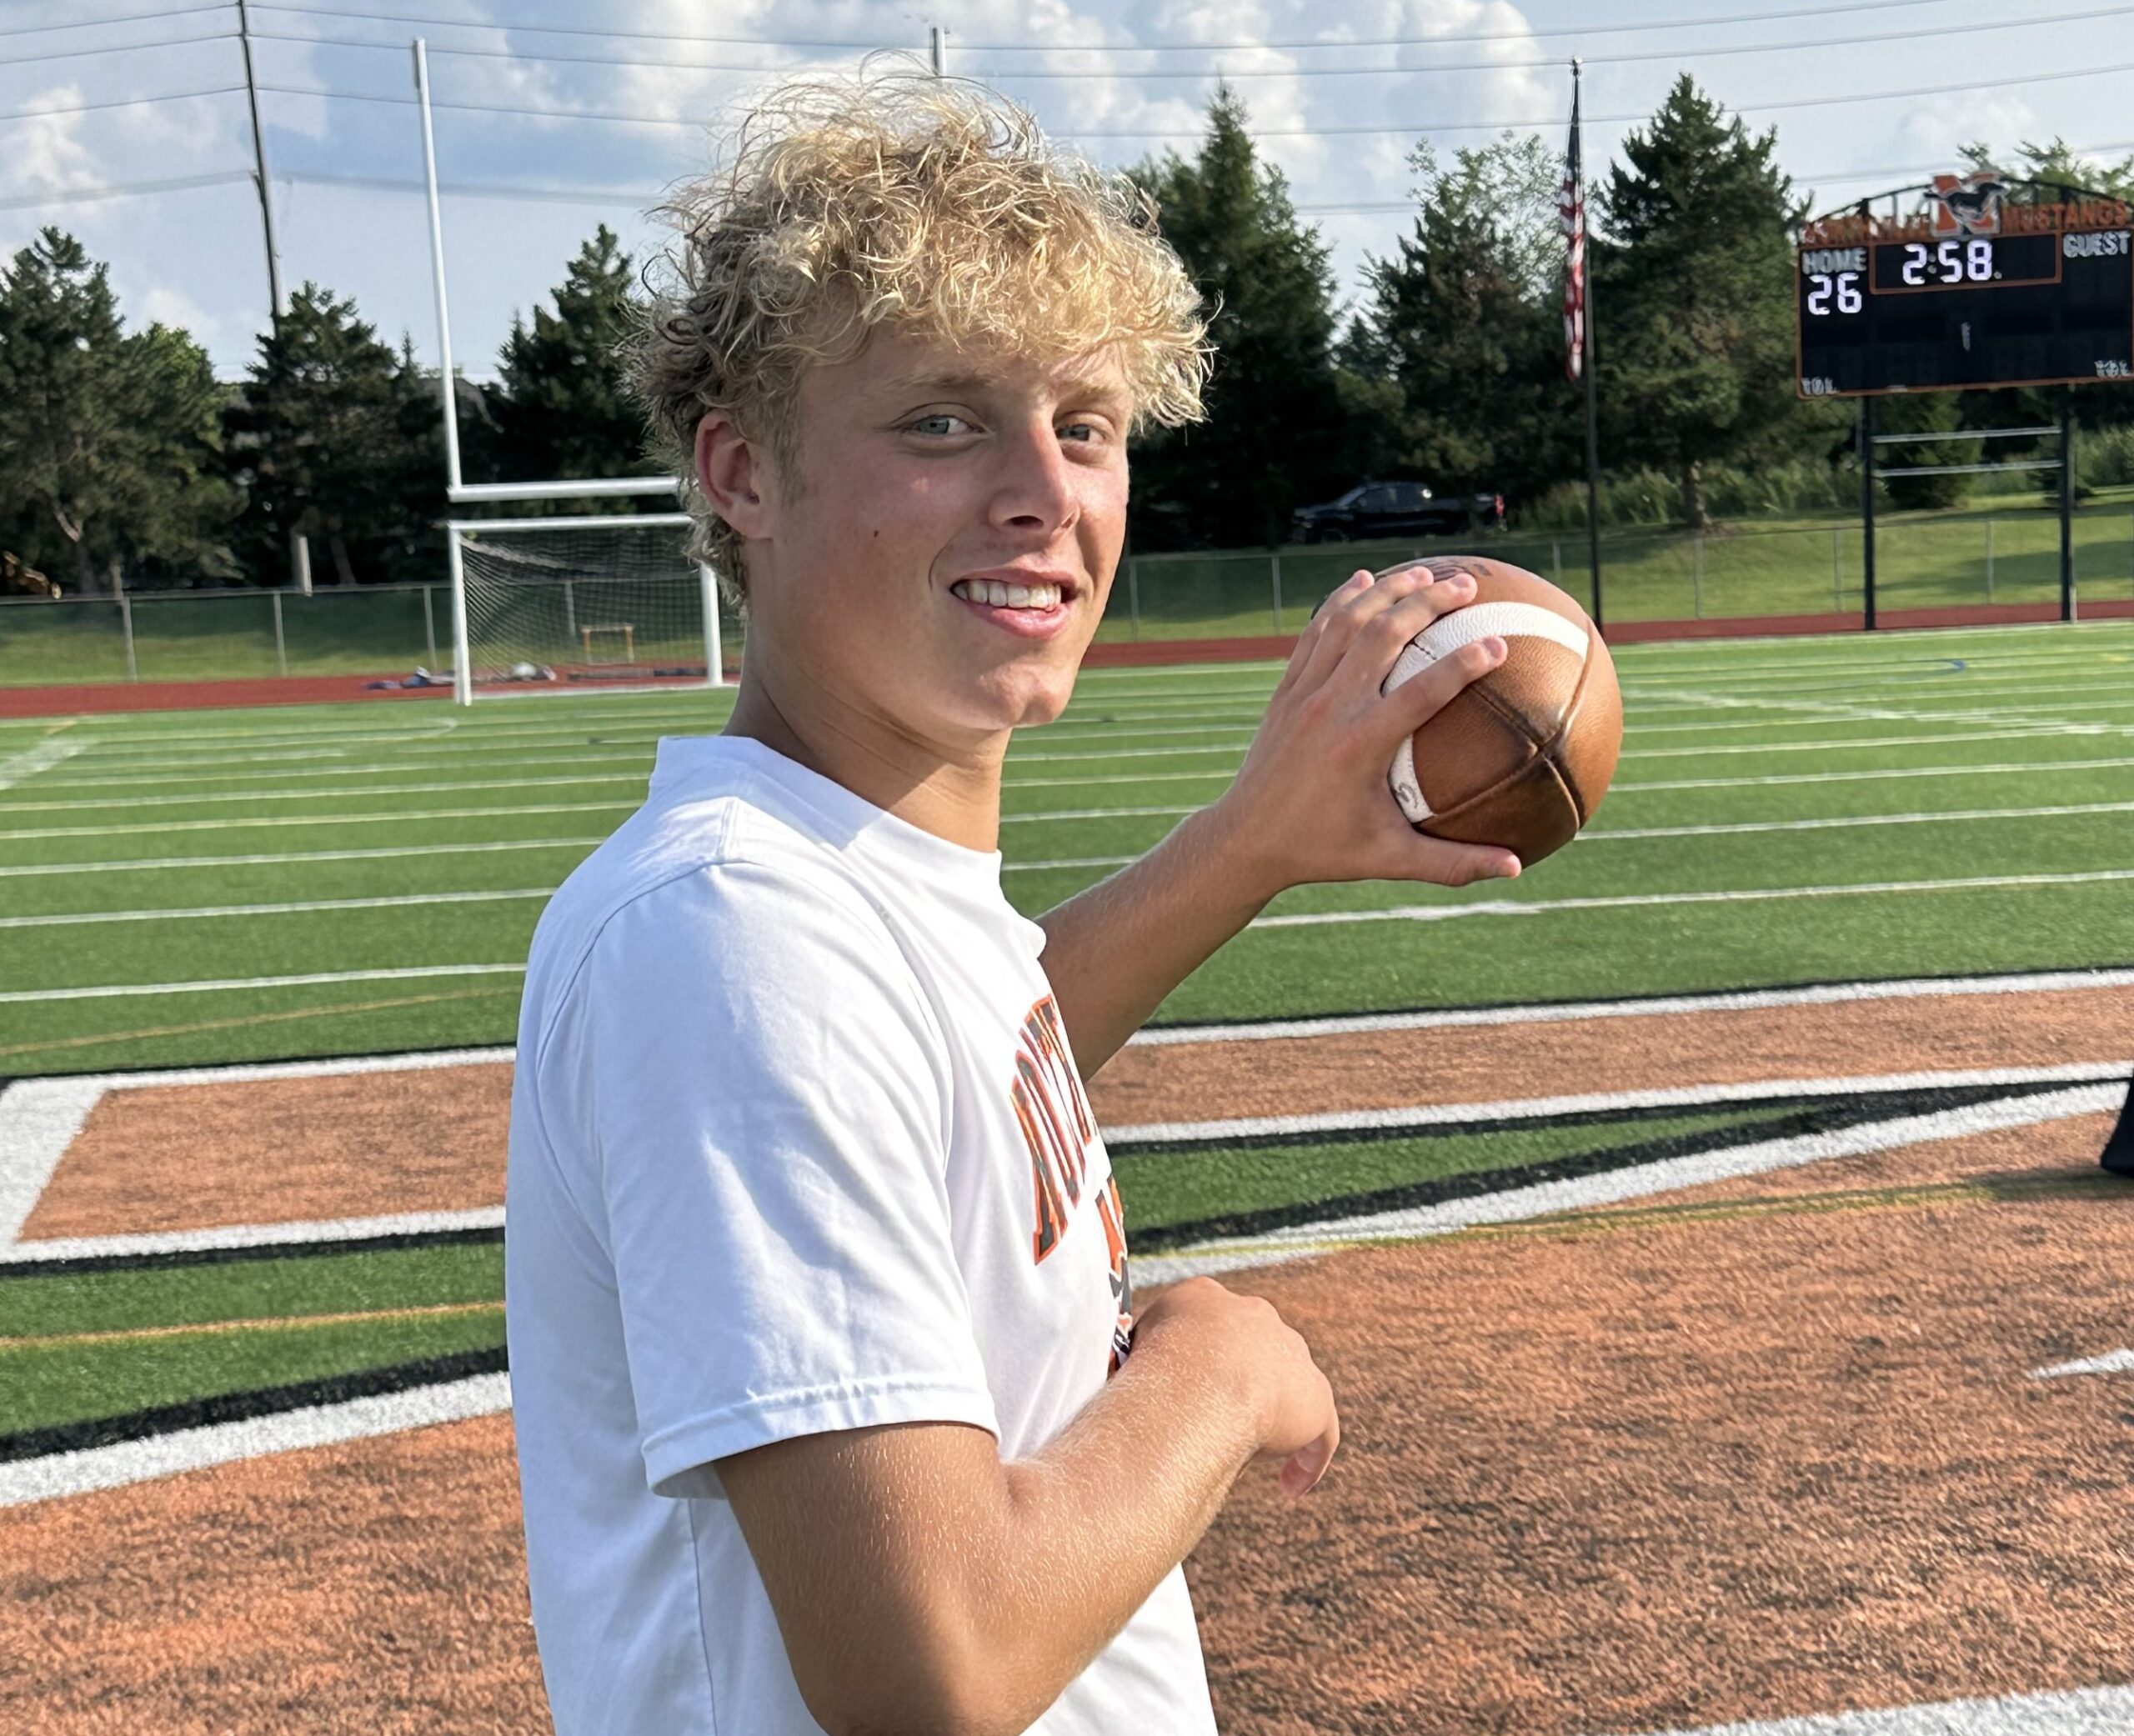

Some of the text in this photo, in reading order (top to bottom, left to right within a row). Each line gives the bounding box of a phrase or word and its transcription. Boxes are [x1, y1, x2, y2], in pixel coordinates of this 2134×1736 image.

[2063, 230, 2131, 258] GUEST
[1802, 248, 1866, 274] HOME
[1807, 273, 1862, 315] 26
